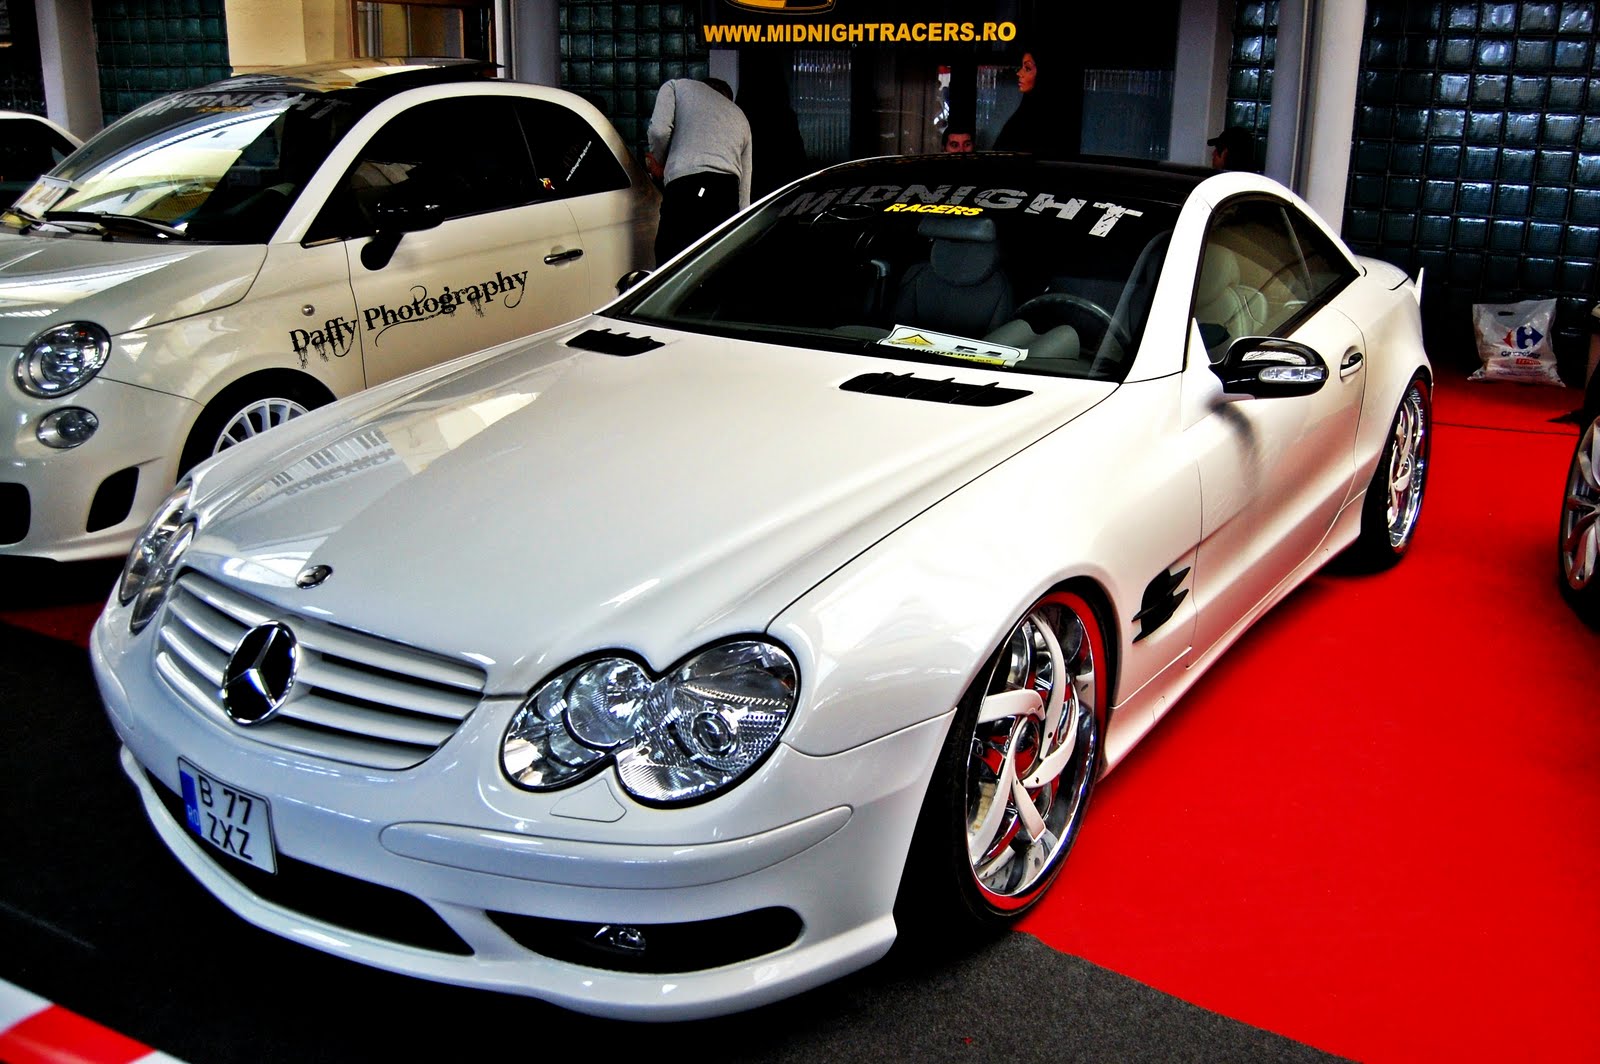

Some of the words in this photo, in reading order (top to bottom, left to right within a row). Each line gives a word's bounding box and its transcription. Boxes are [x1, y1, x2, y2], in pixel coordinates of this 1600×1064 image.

[703, 22, 1017, 42] WWW.MIDNIGHTRACERS.RO
[779, 184, 1143, 238] MIDNIGHT
[884, 204, 983, 216] RACERS
[289, 315, 357, 369] Daffy
[363, 270, 528, 347] Photography
[198, 774, 213, 807] B
[223, 788, 252, 825] 77
[207, 812, 253, 860] ZXZ
